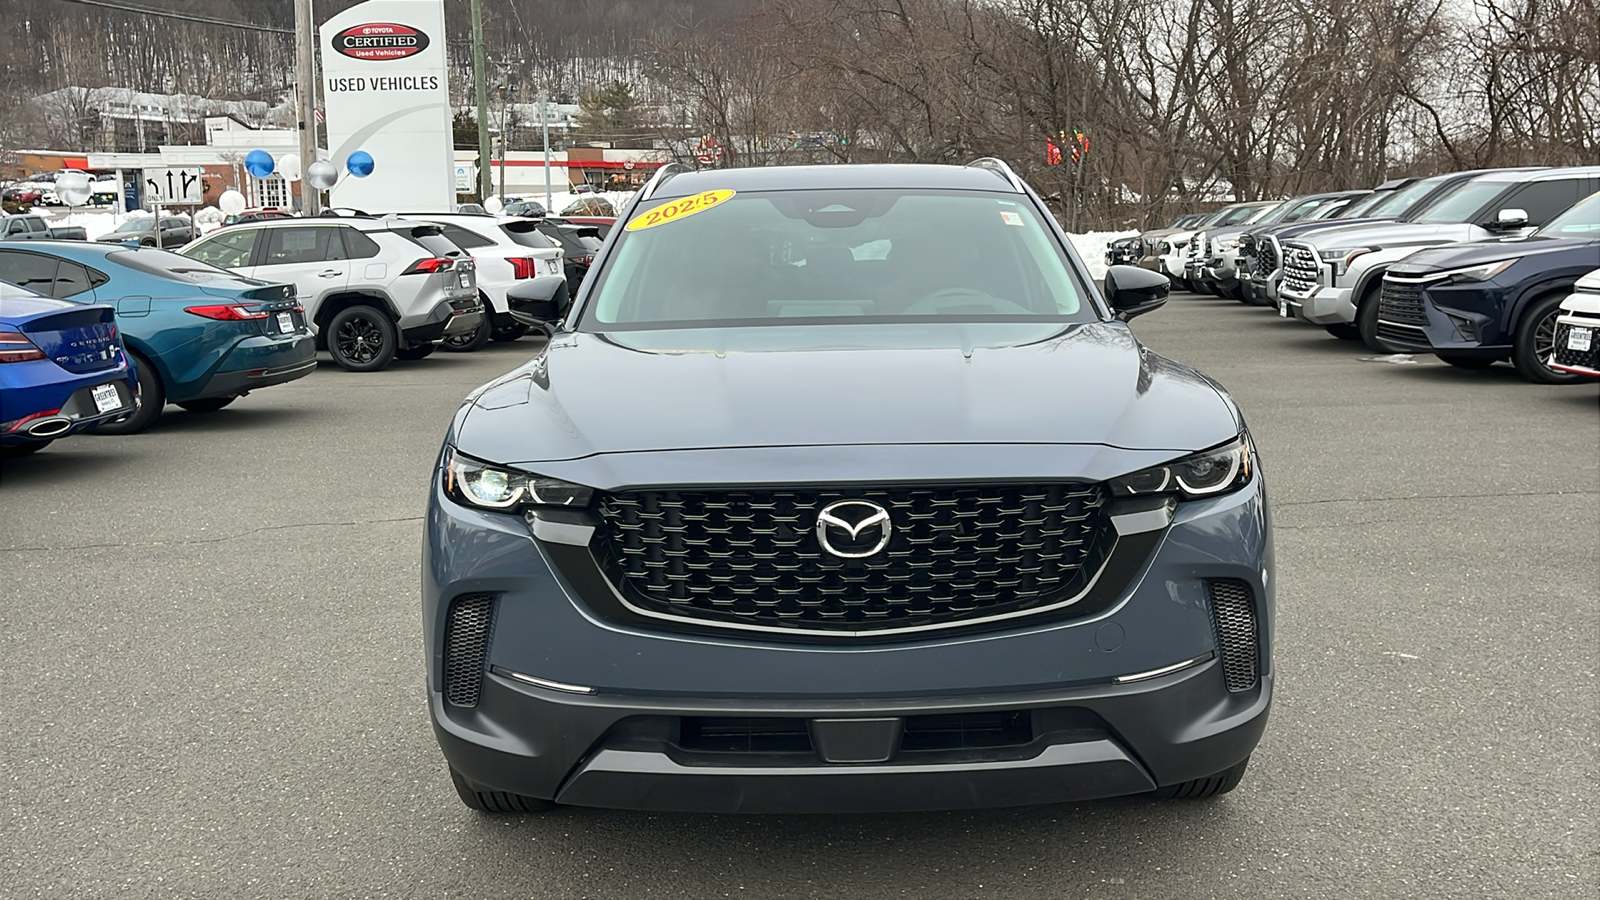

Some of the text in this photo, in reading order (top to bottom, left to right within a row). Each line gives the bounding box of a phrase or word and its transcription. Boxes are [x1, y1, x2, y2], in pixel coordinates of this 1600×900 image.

[343, 36, 417, 48] CERTIFIED
[329, 76, 438, 92] USED VEHICLES
